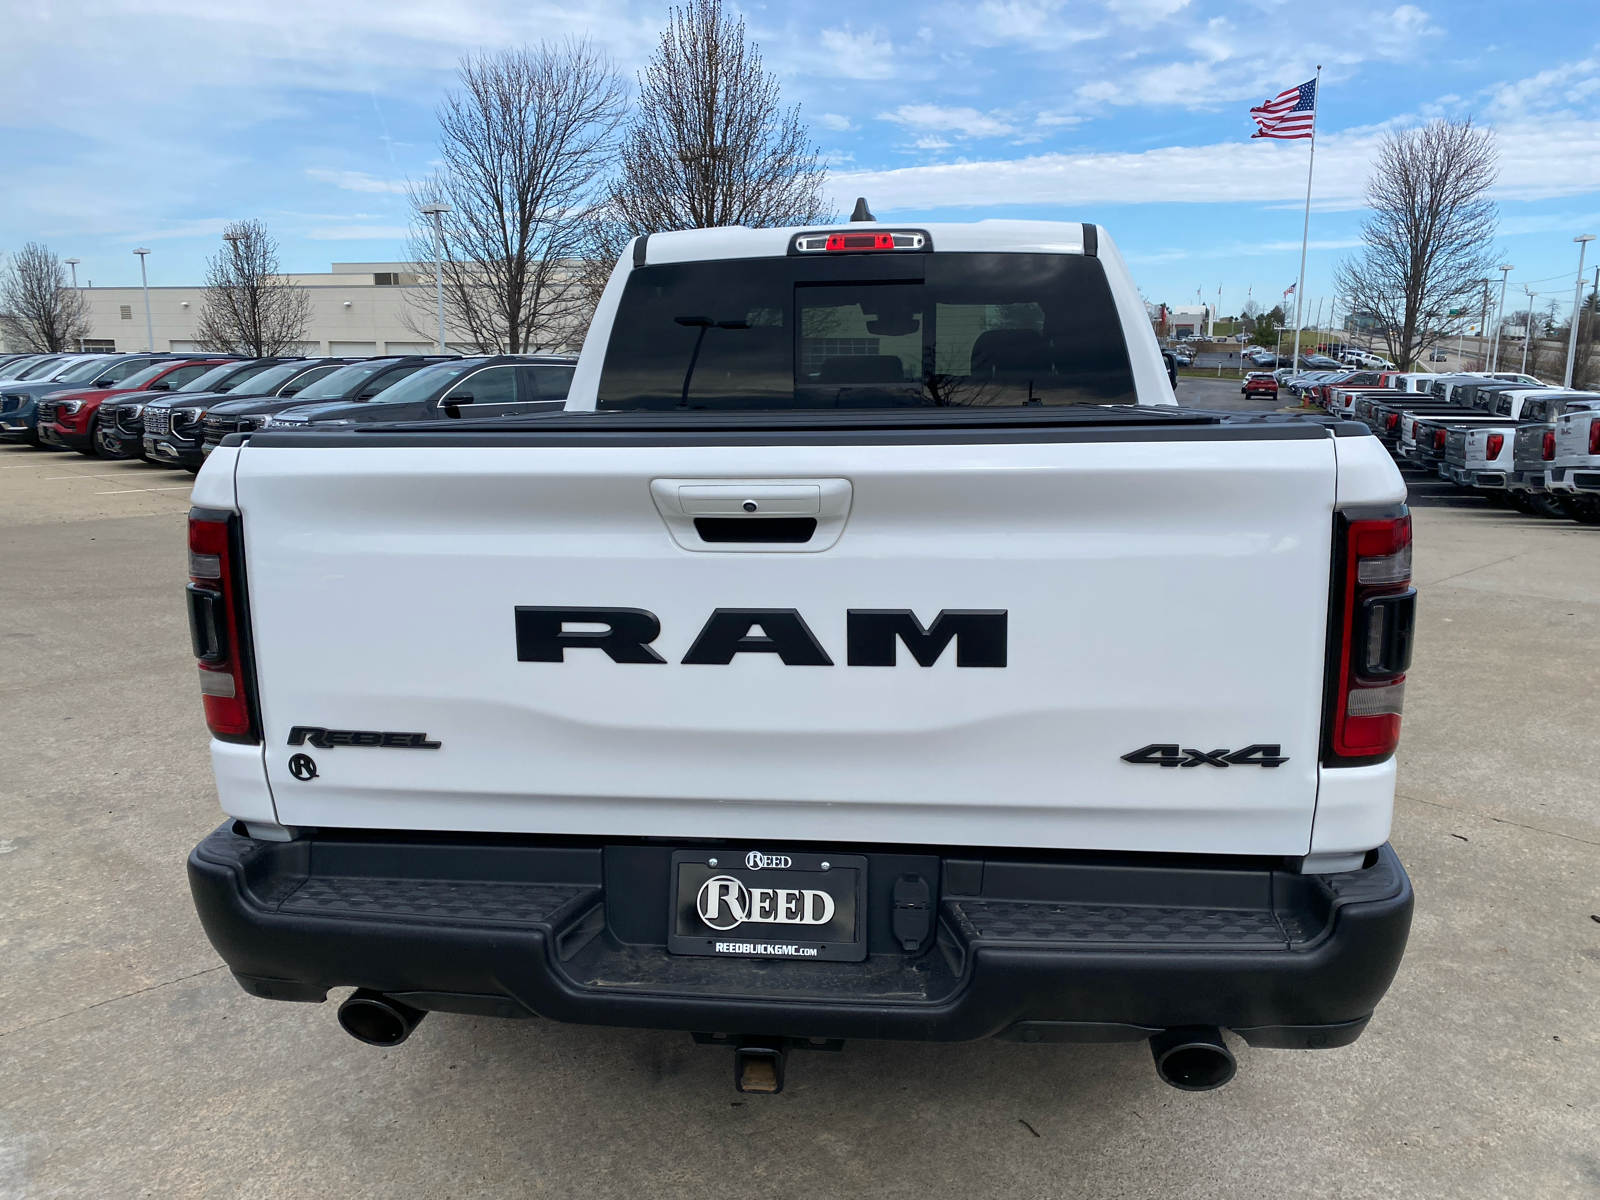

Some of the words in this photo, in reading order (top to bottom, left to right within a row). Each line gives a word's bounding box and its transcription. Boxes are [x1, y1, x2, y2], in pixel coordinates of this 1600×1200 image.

[515, 605, 1008, 668] RAM
[287, 725, 442, 749] REBEL
[745, 851, 792, 870] REED
[696, 875, 835, 930] REED
